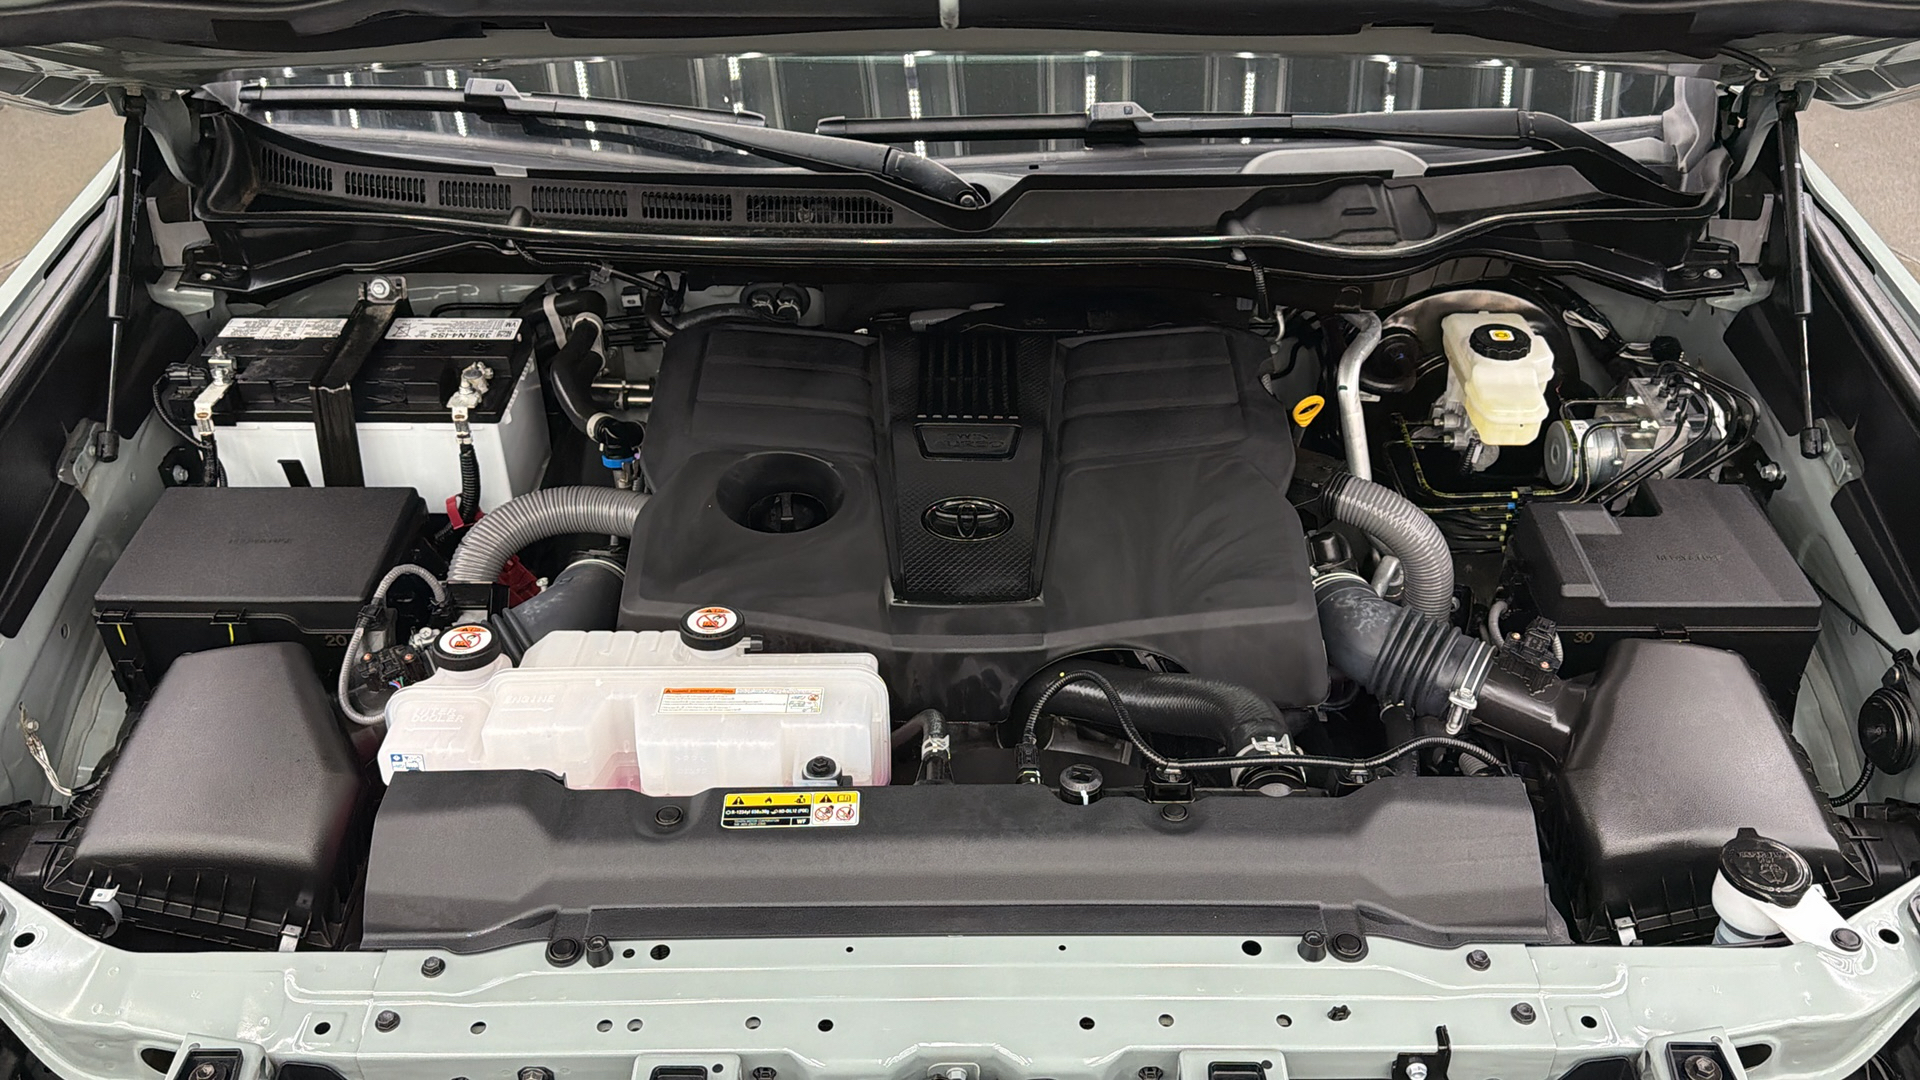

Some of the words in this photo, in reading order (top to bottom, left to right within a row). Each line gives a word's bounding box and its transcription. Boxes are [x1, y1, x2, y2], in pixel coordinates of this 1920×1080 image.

[324, 634, 348, 646] 20
[1573, 631, 1595, 643] 30
[503, 694, 556, 703] ENGINE
